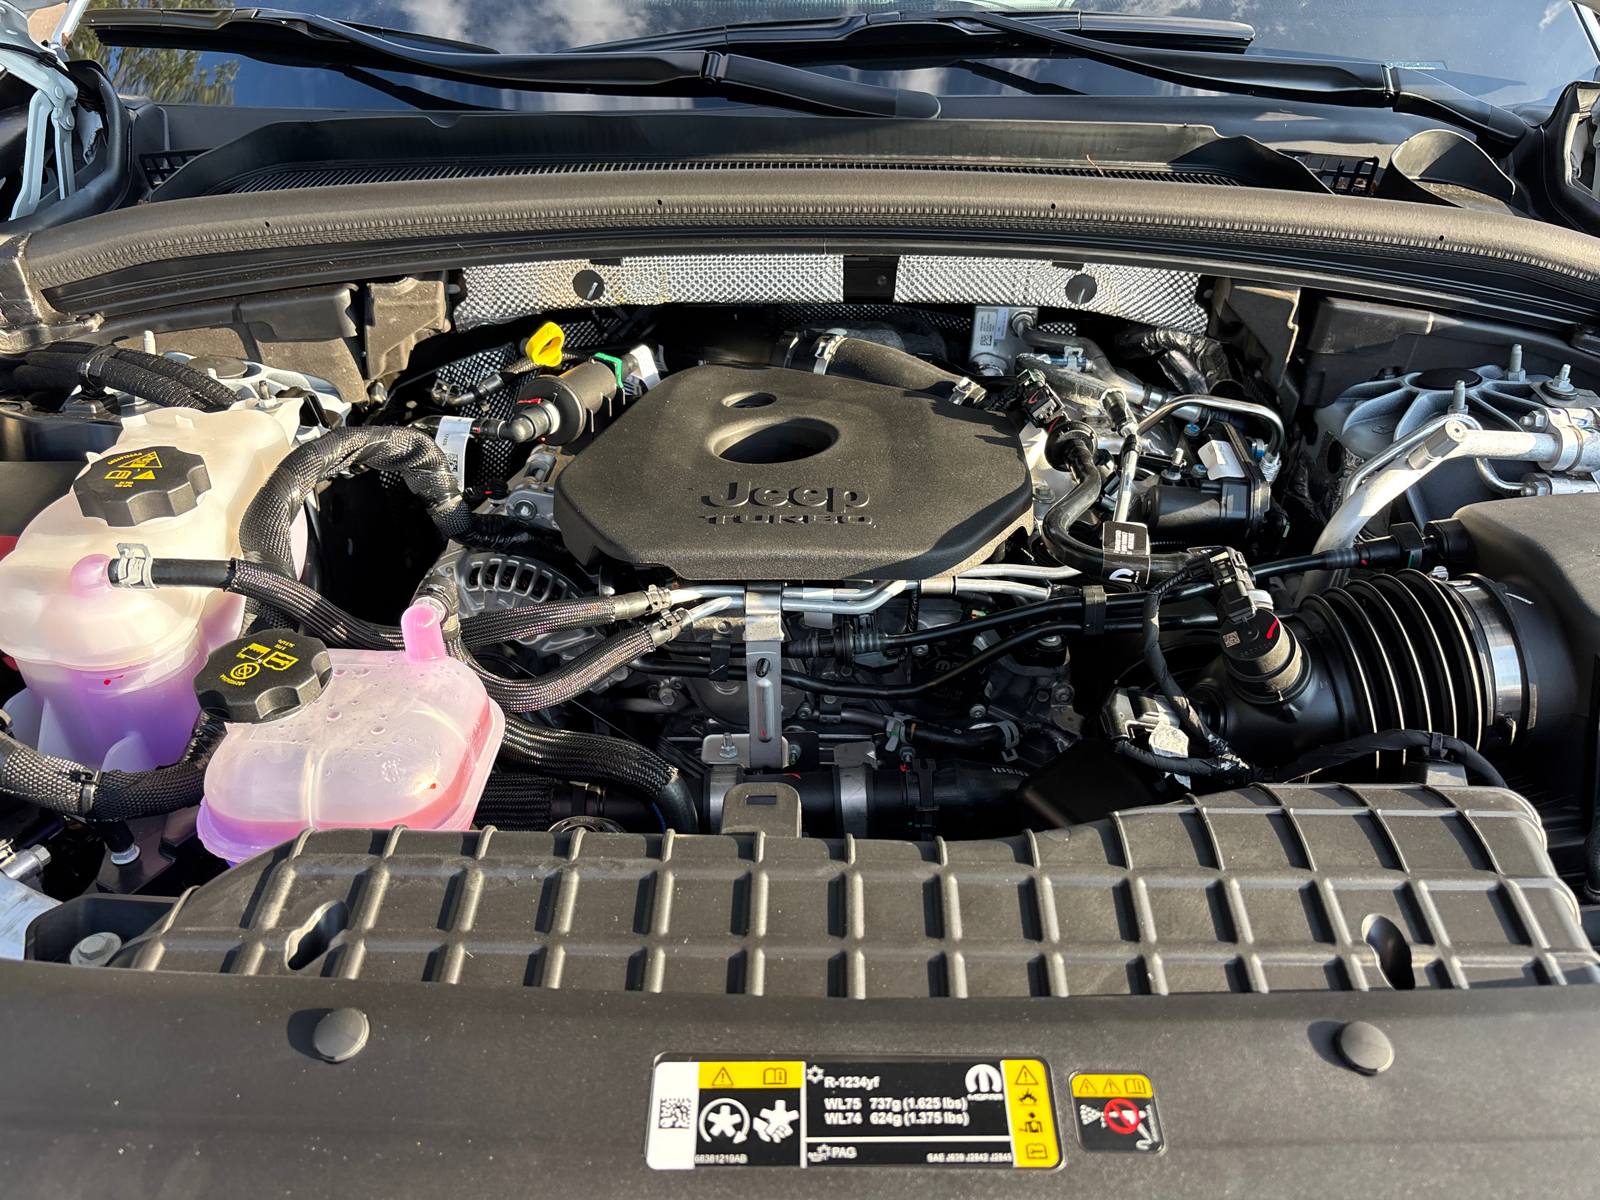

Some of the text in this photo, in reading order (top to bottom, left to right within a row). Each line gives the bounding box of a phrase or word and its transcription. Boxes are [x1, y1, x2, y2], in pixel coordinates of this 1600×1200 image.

[700, 482, 870, 513] Jeep
[697, 514, 874, 525] TURBO
[823, 1075, 880, 1091] R-1234yf
[823, 1096, 968, 1113] WL75 737g (1.625 lbs)
[823, 1111, 970, 1128] WL74 624g (1.375 lbs)
[832, 1146, 858, 1159] PAG
[926, 1152, 946, 1163] SAE
